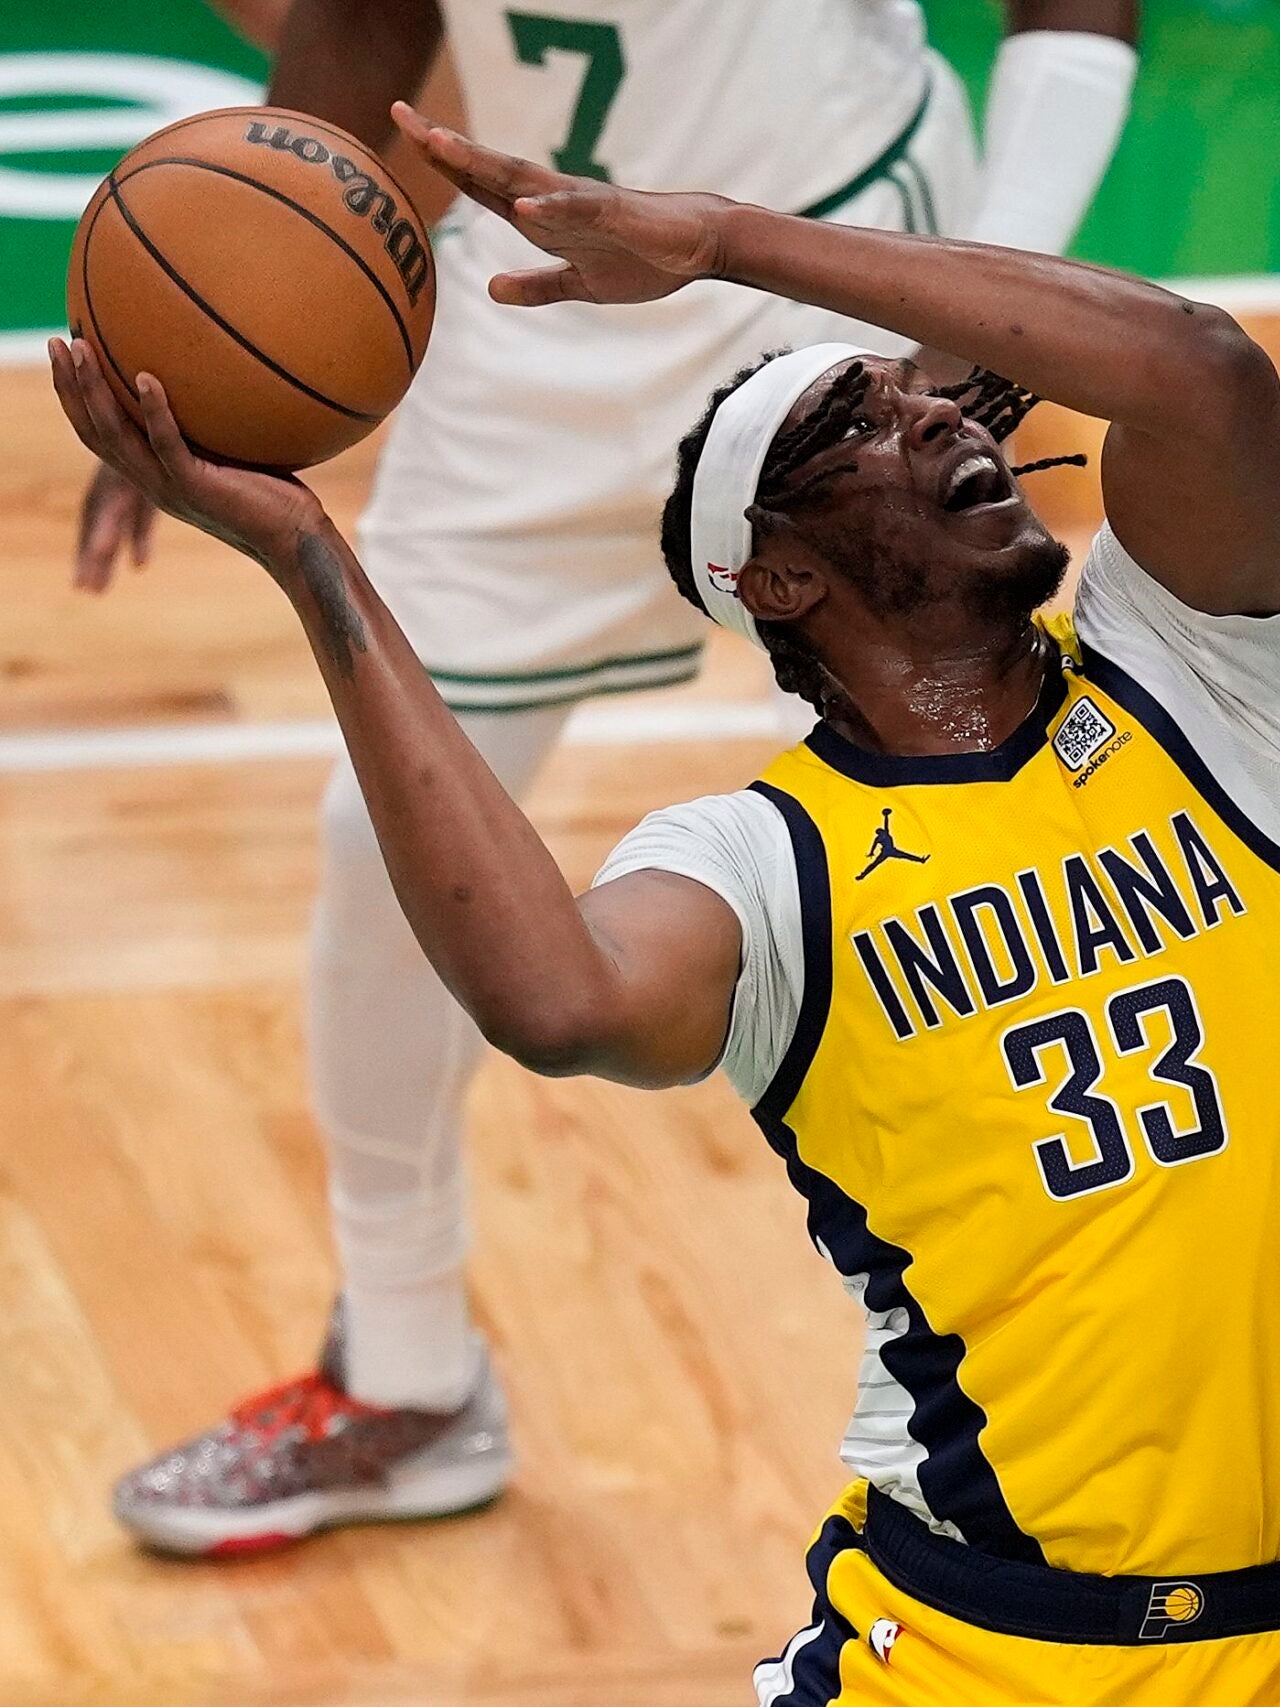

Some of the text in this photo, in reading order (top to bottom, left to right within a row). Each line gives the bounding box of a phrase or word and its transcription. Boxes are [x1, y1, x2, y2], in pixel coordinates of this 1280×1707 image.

[504, 11, 627, 183] 7
[1072, 730, 1133, 789] spokenote
[850, 808, 1248, 1042] INDIANA
[999, 973, 1230, 1203] 33
